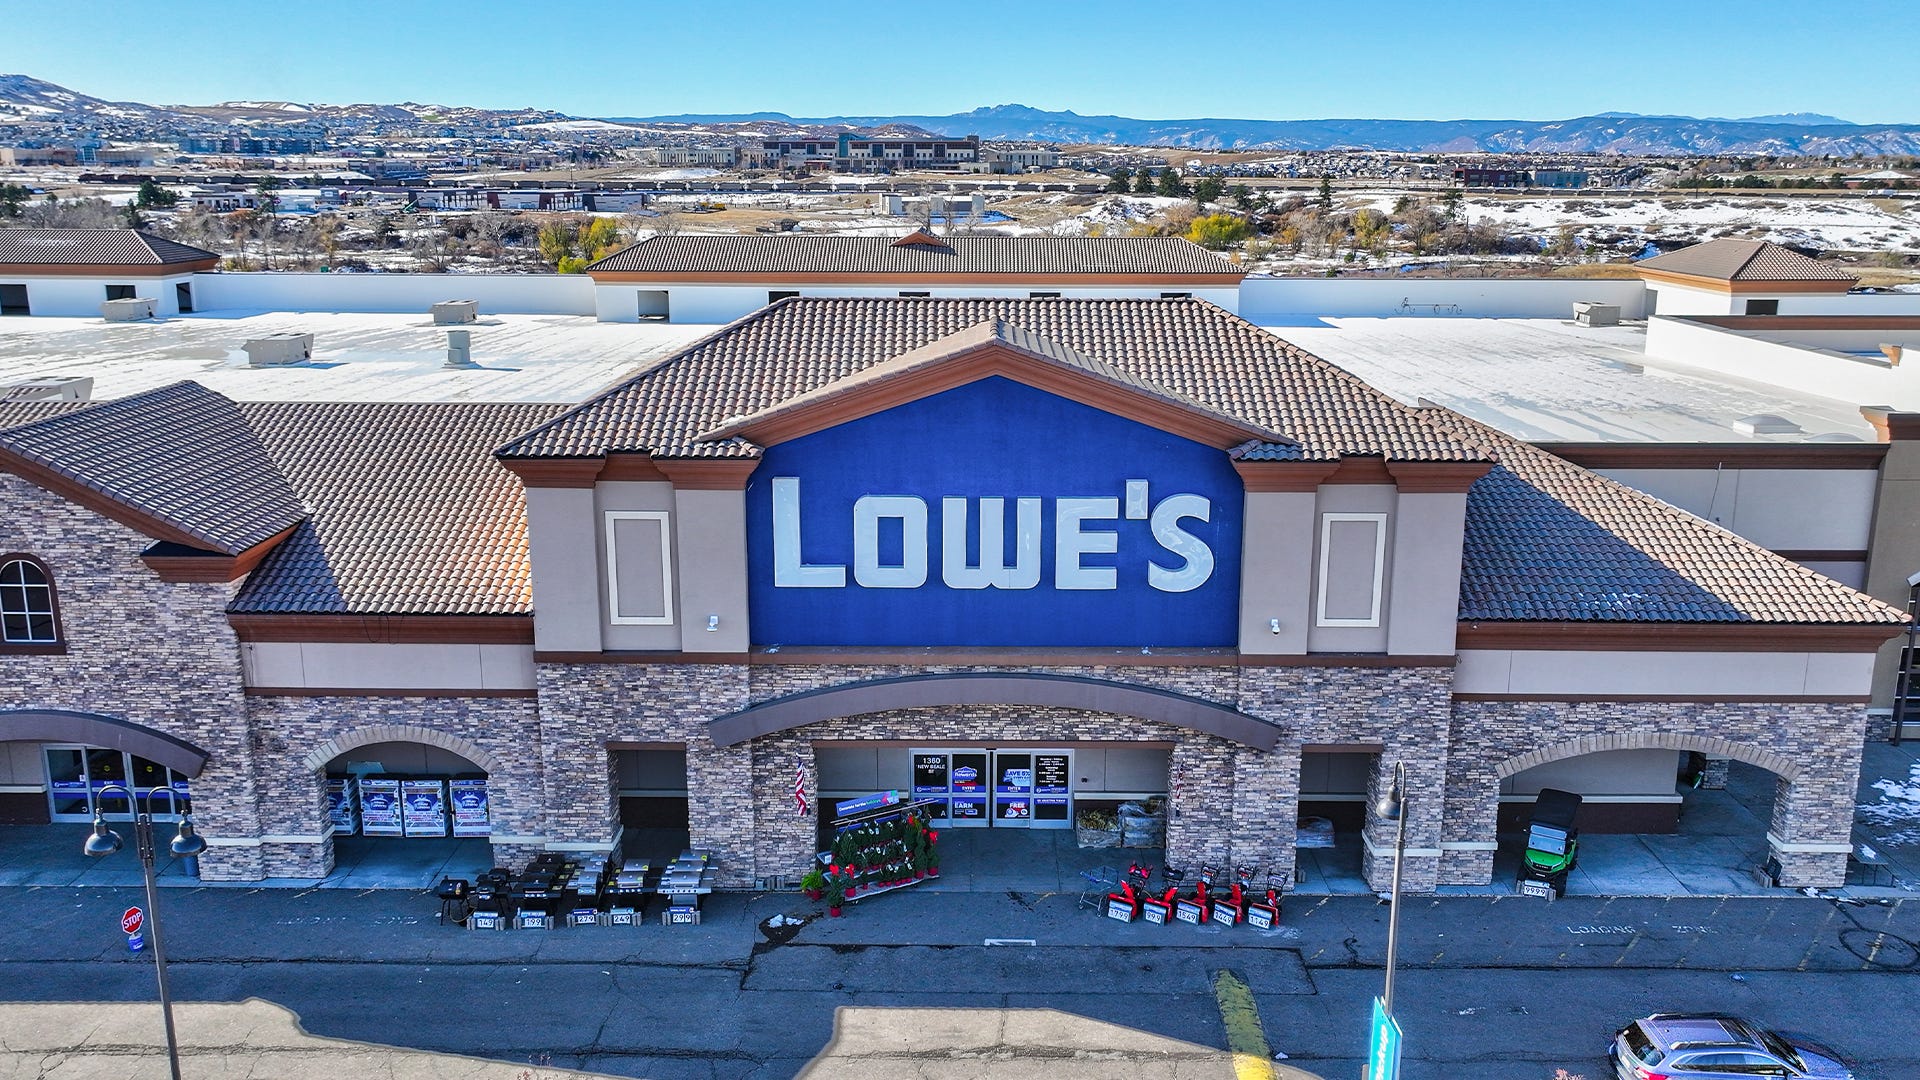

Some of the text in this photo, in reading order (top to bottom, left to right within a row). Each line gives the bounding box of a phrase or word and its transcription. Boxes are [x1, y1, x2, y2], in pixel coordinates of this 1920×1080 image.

[772, 477, 1215, 592] LOWE'S
[123, 912, 142, 929] STOP
[1567, 925, 1636, 934] LOADING
